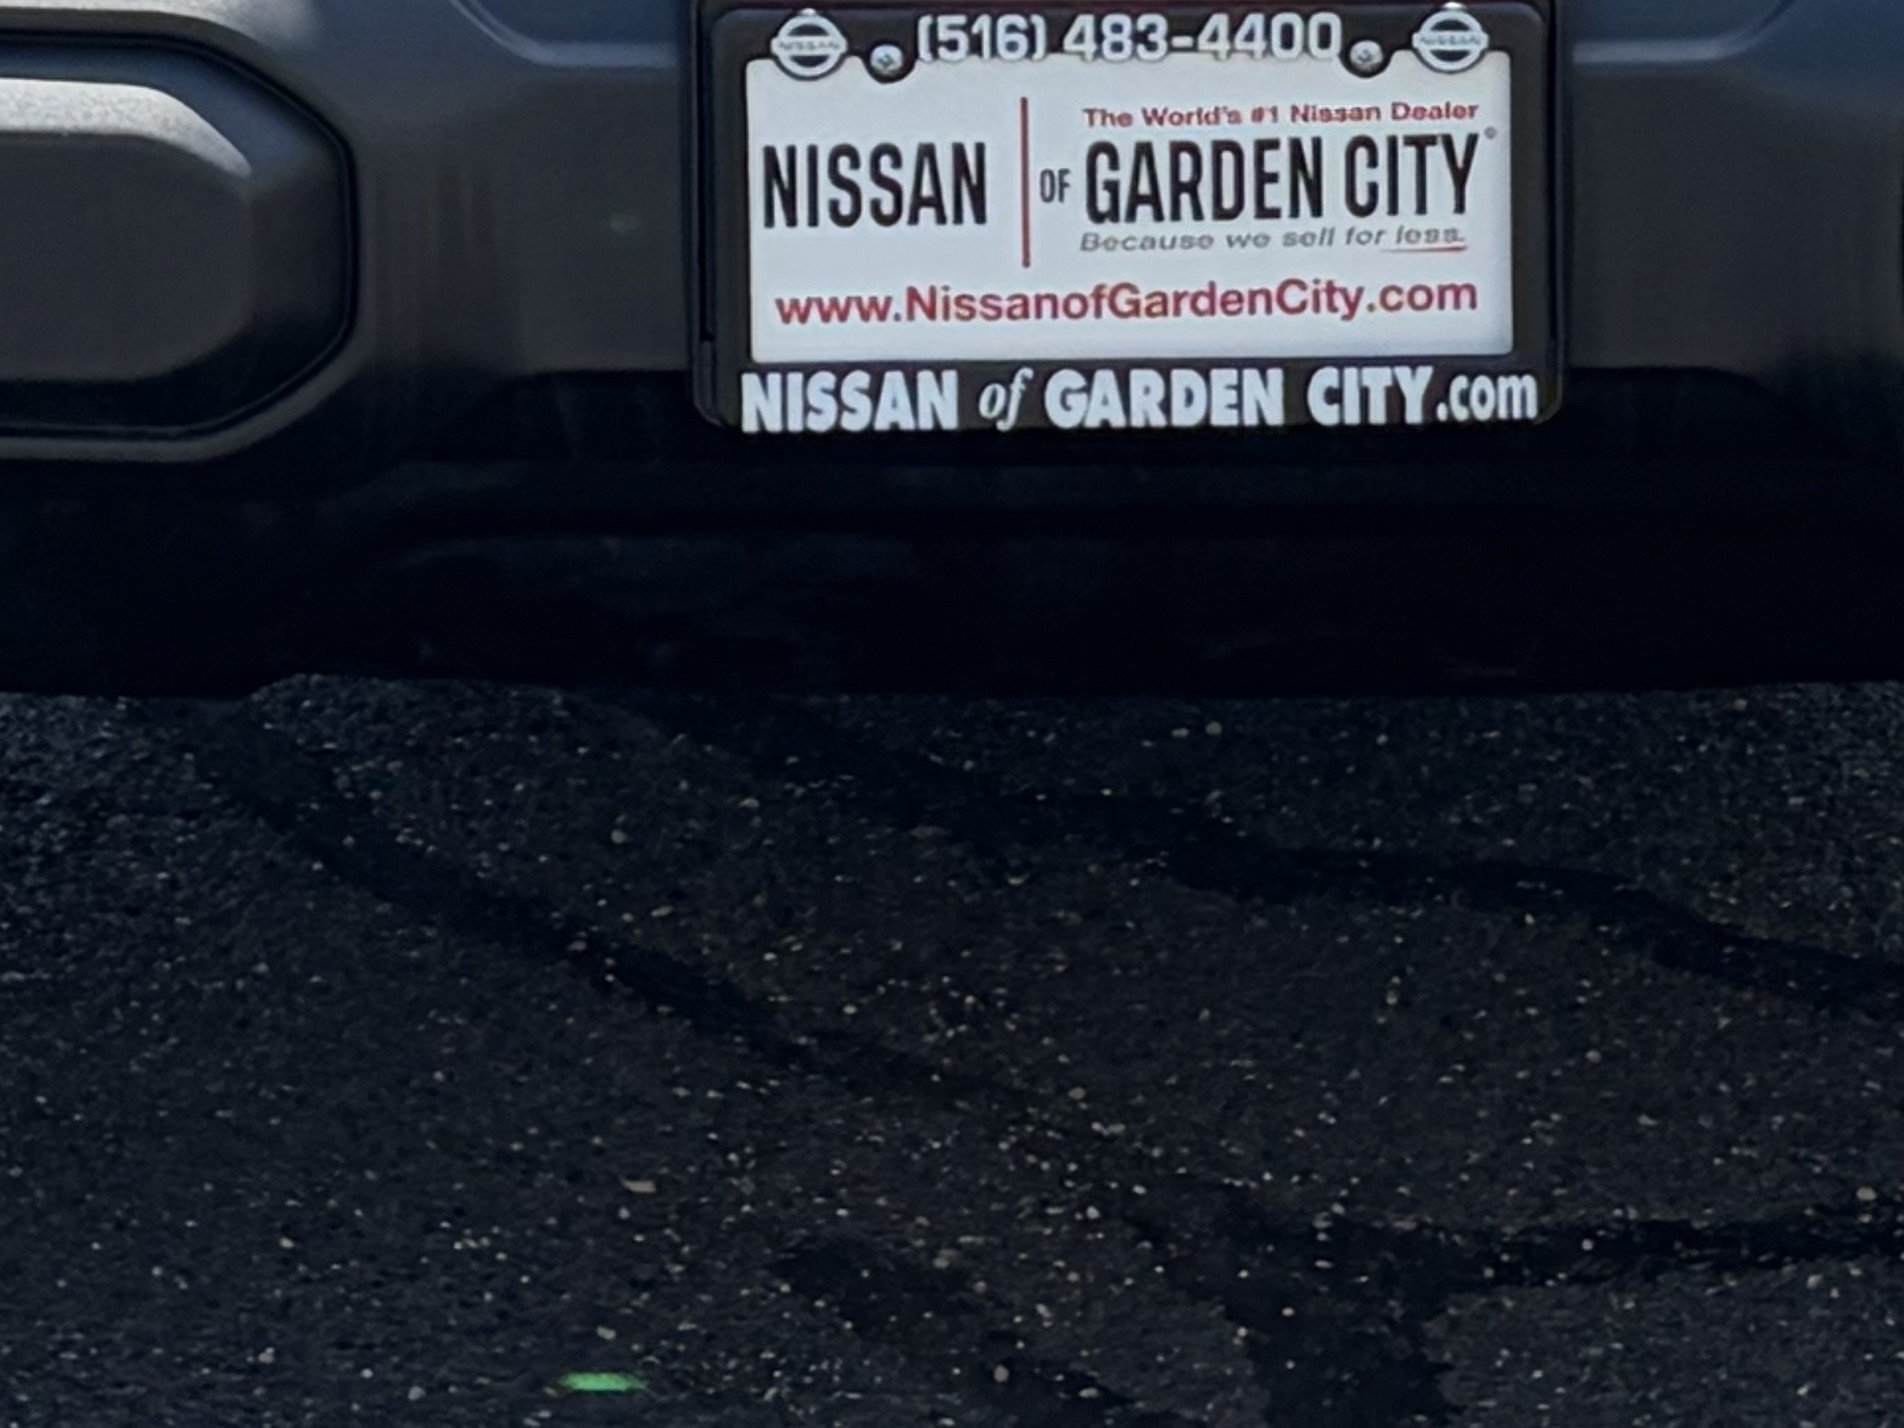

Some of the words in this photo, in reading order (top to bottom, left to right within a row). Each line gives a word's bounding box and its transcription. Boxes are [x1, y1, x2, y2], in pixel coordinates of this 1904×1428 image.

[918, 14, 1046, 62] (516)
[1063, 11, 1343, 62] 483-4400
[1082, 108, 1132, 128] The
[1141, 105, 1242, 128] World's
[1251, 105, 1279, 126] #1
[1290, 104, 1382, 125] Nissan
[1391, 101, 1480, 122] Dealer
[762, 141, 988, 229] NISSAN
[1039, 168, 1071, 204] OF
[1085, 135, 1324, 225] GARDEN
[1079, 230, 1215, 253] Because
[1226, 232, 1271, 250] we
[1282, 226, 1336, 248] sell
[1345, 225, 1384, 247] for
[1395, 224, 1467, 245] less.
[775, 277, 1478, 325] www.NissanofGardenCity.com
[741, 367, 959, 433] NISSAN
[979, 367, 1034, 431] of
[1044, 366, 1285, 430] GARDEN
[1307, 365, 1539, 426] CITY.com
